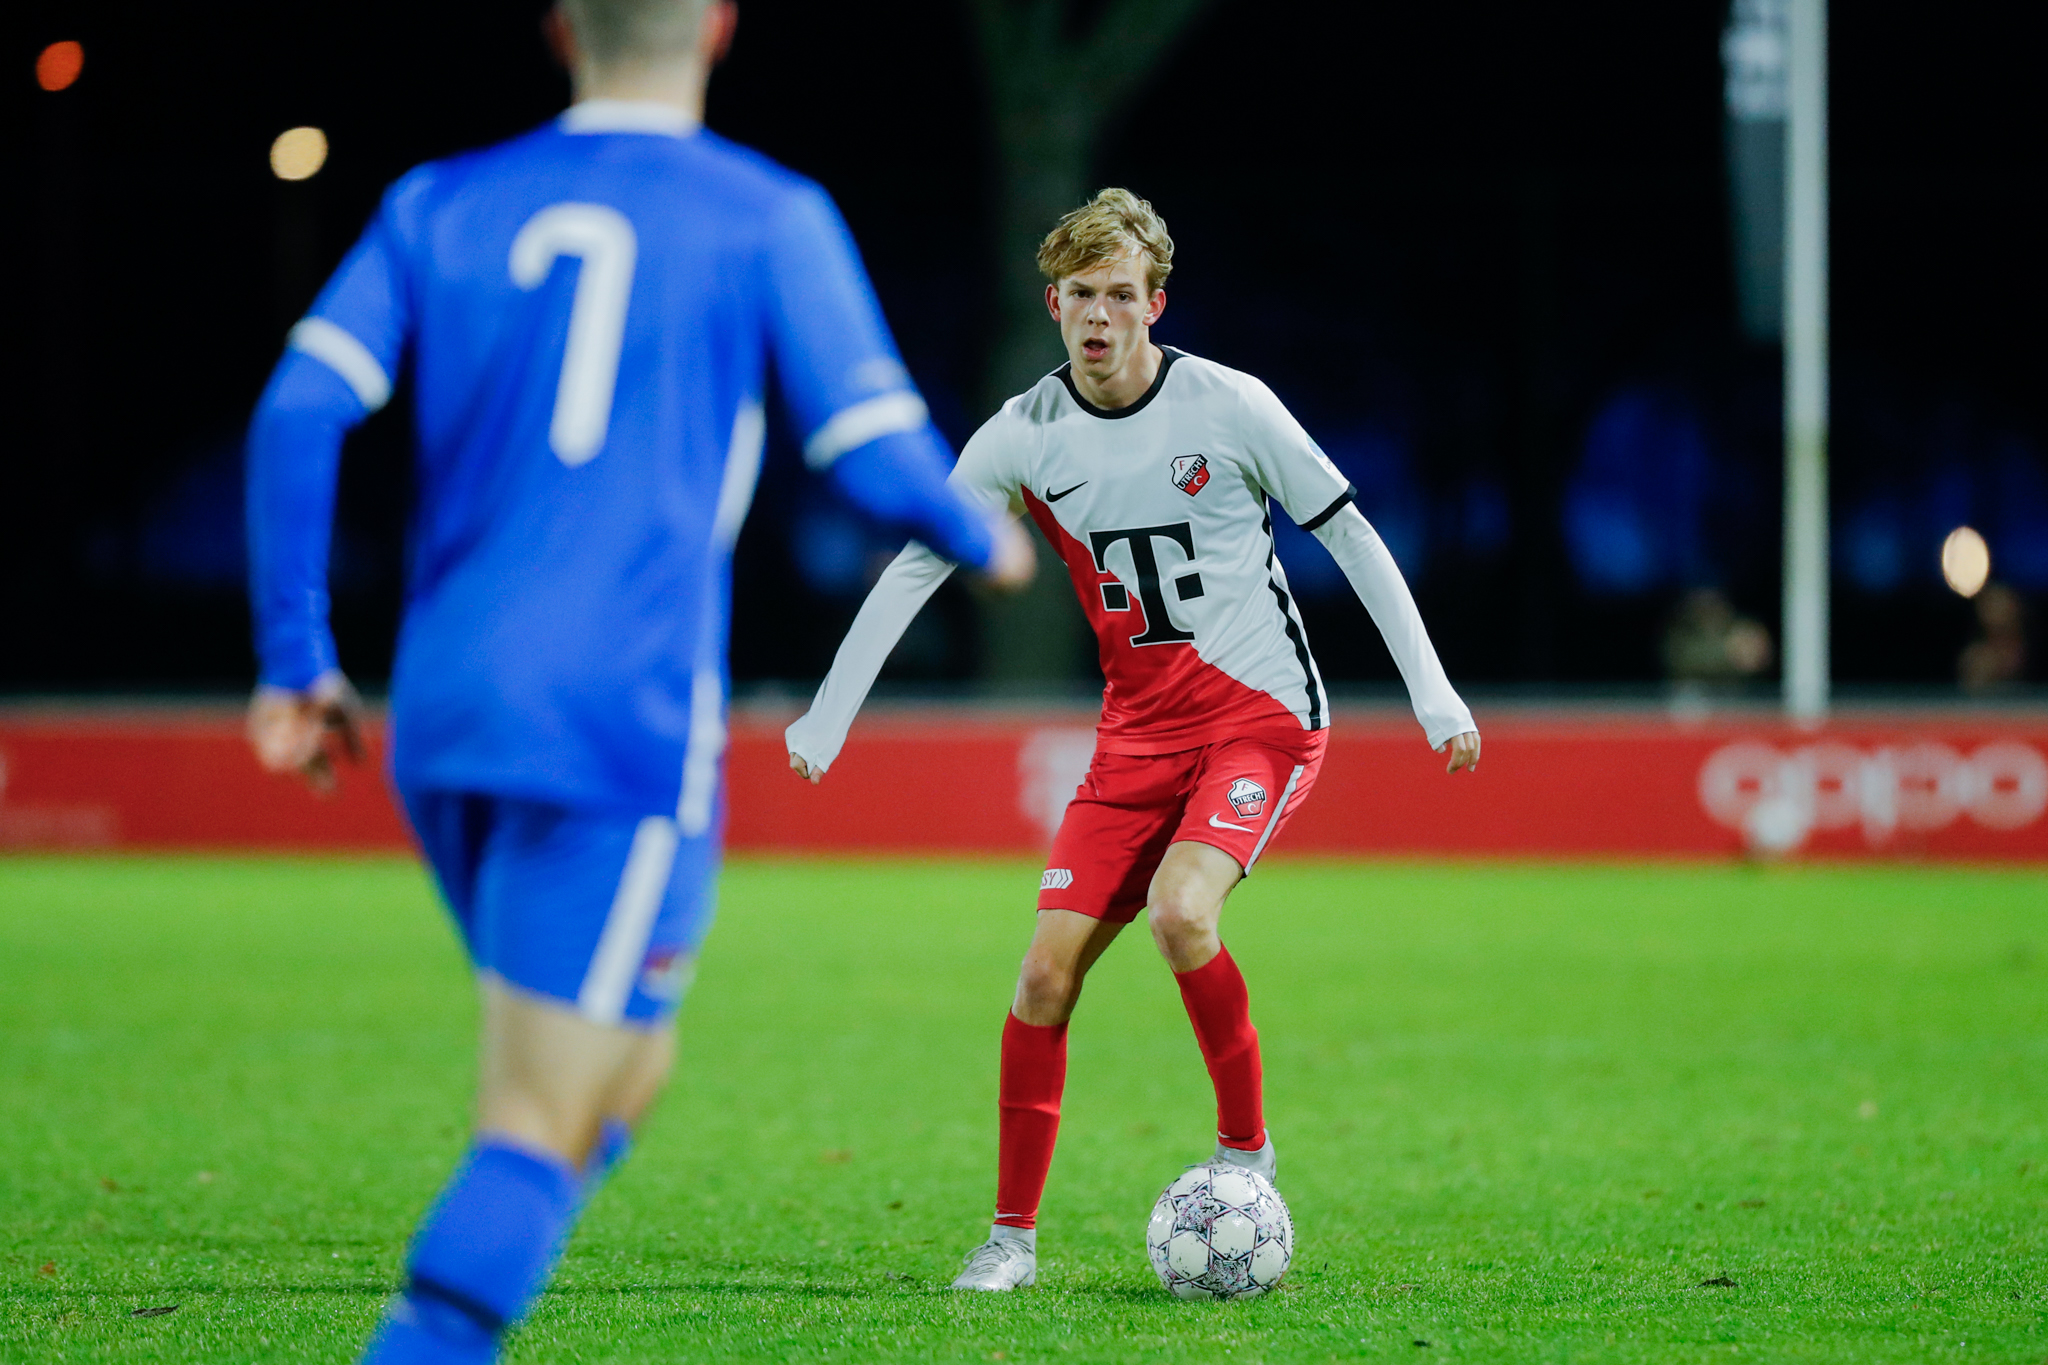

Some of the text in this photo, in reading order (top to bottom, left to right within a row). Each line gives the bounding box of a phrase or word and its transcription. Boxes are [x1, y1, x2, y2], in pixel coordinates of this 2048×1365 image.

[508, 202, 637, 467] 7
[1179, 460, 1186, 471] F
[1177, 457, 1206, 490] UTRECHT
[1193, 475, 1204, 486] C
[1089, 521, 1196, 647] T
[1241, 783, 1250, 791] F
[1232, 791, 1265, 806] UTRECHT
[1247, 803, 1257, 814] C
